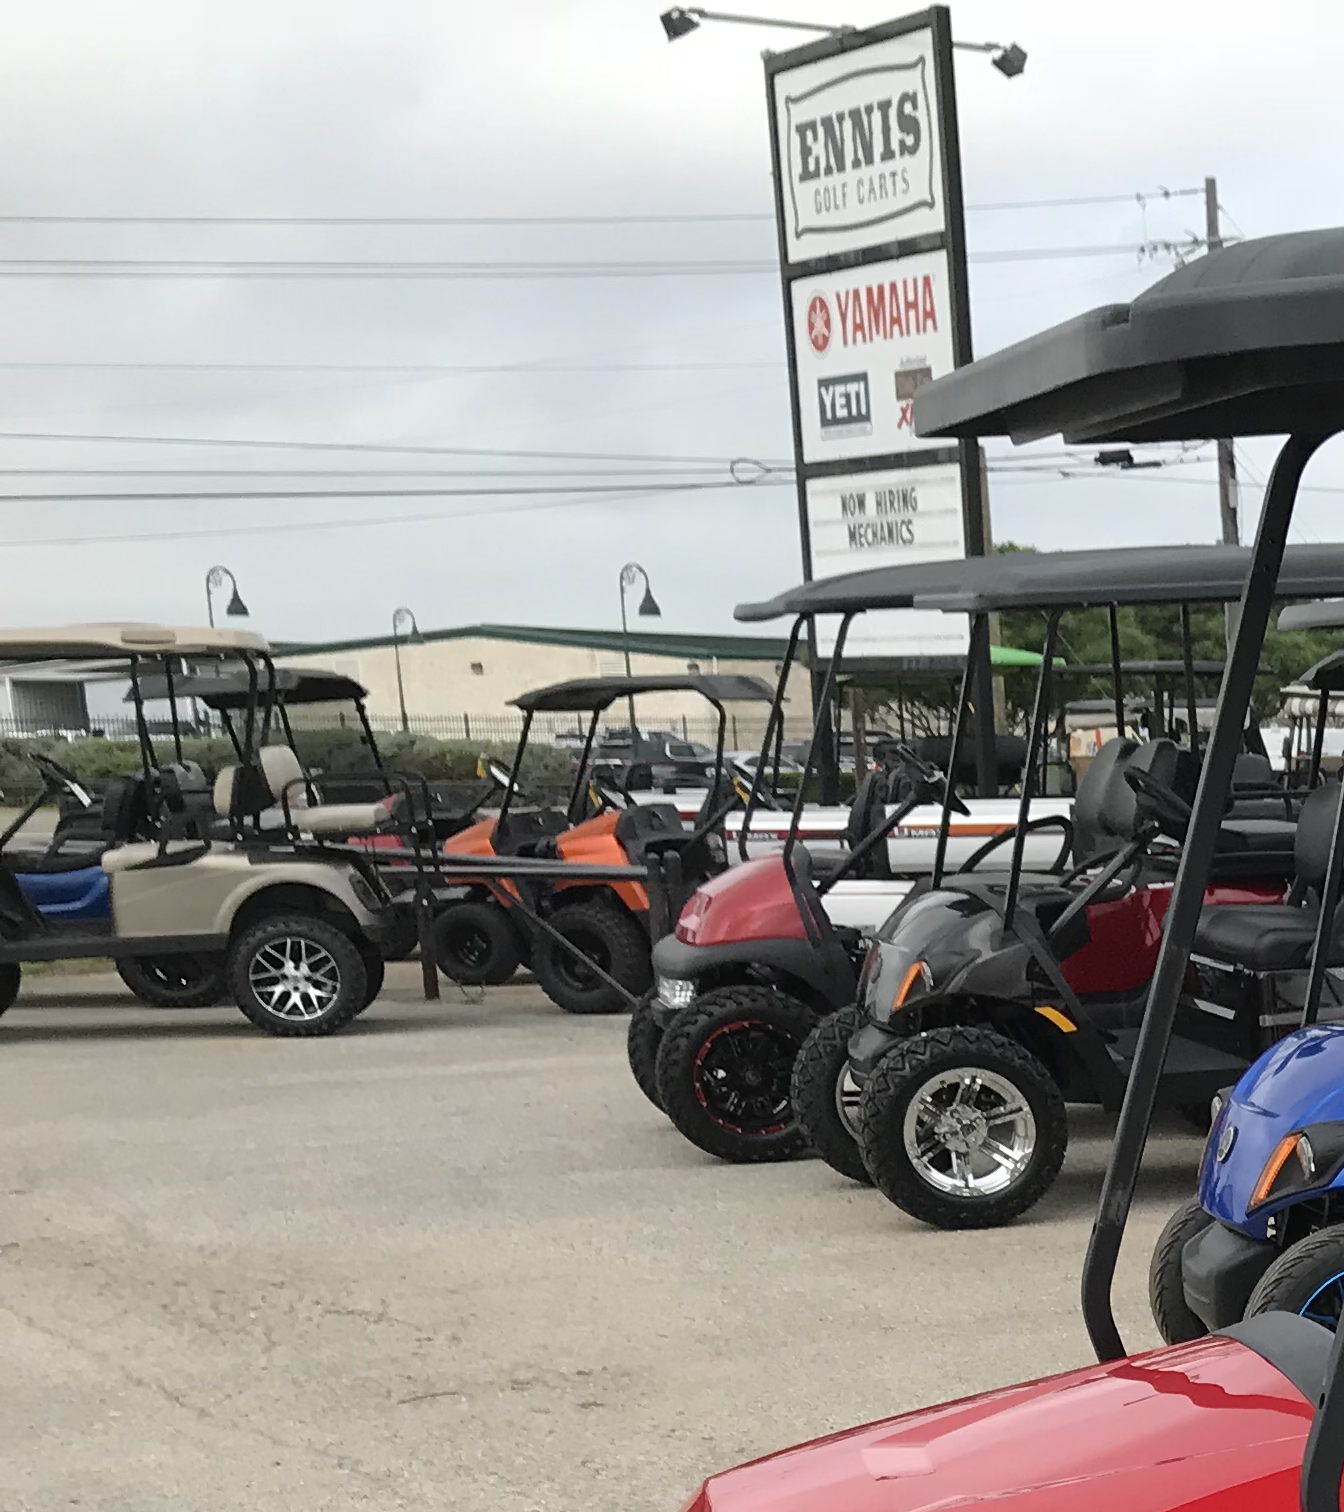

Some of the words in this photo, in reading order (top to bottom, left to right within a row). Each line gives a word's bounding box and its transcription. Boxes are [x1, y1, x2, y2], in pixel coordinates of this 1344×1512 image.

[795, 89, 922, 183] ENNIS
[814, 181, 848, 215] GOLF
[857, 166, 910, 205] CARTS
[835, 274, 938, 347] YAMAHA
[820, 380, 867, 421] YETI
[841, 492, 866, 518] NOW
[875, 487, 918, 515] HIRING
[848, 519, 915, 548] MECHANICS
